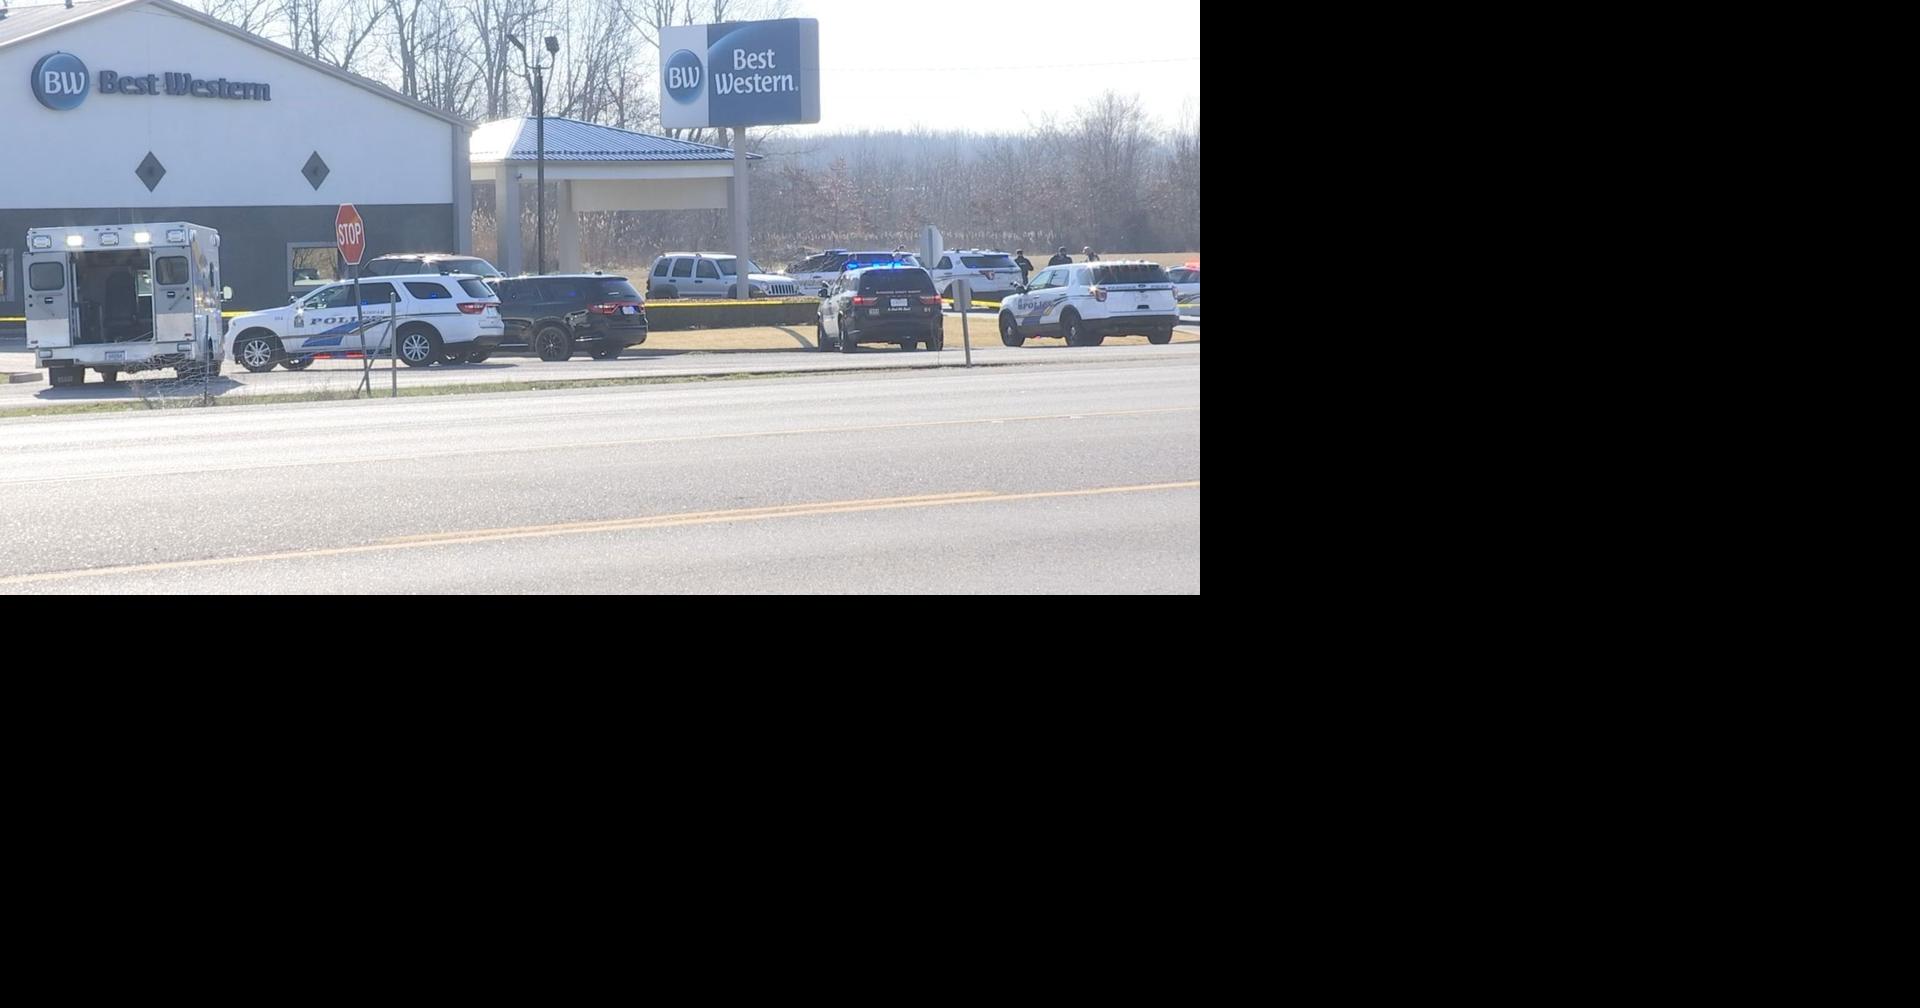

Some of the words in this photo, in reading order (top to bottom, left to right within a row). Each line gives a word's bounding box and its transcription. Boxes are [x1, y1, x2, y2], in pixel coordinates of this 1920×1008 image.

[733, 49, 776, 70] Best
[44, 71, 85, 95] BW
[98, 70, 160, 96] Best
[164, 72, 272, 101] Western
[669, 66, 700, 89] BW
[338, 222, 362, 246] STOP
